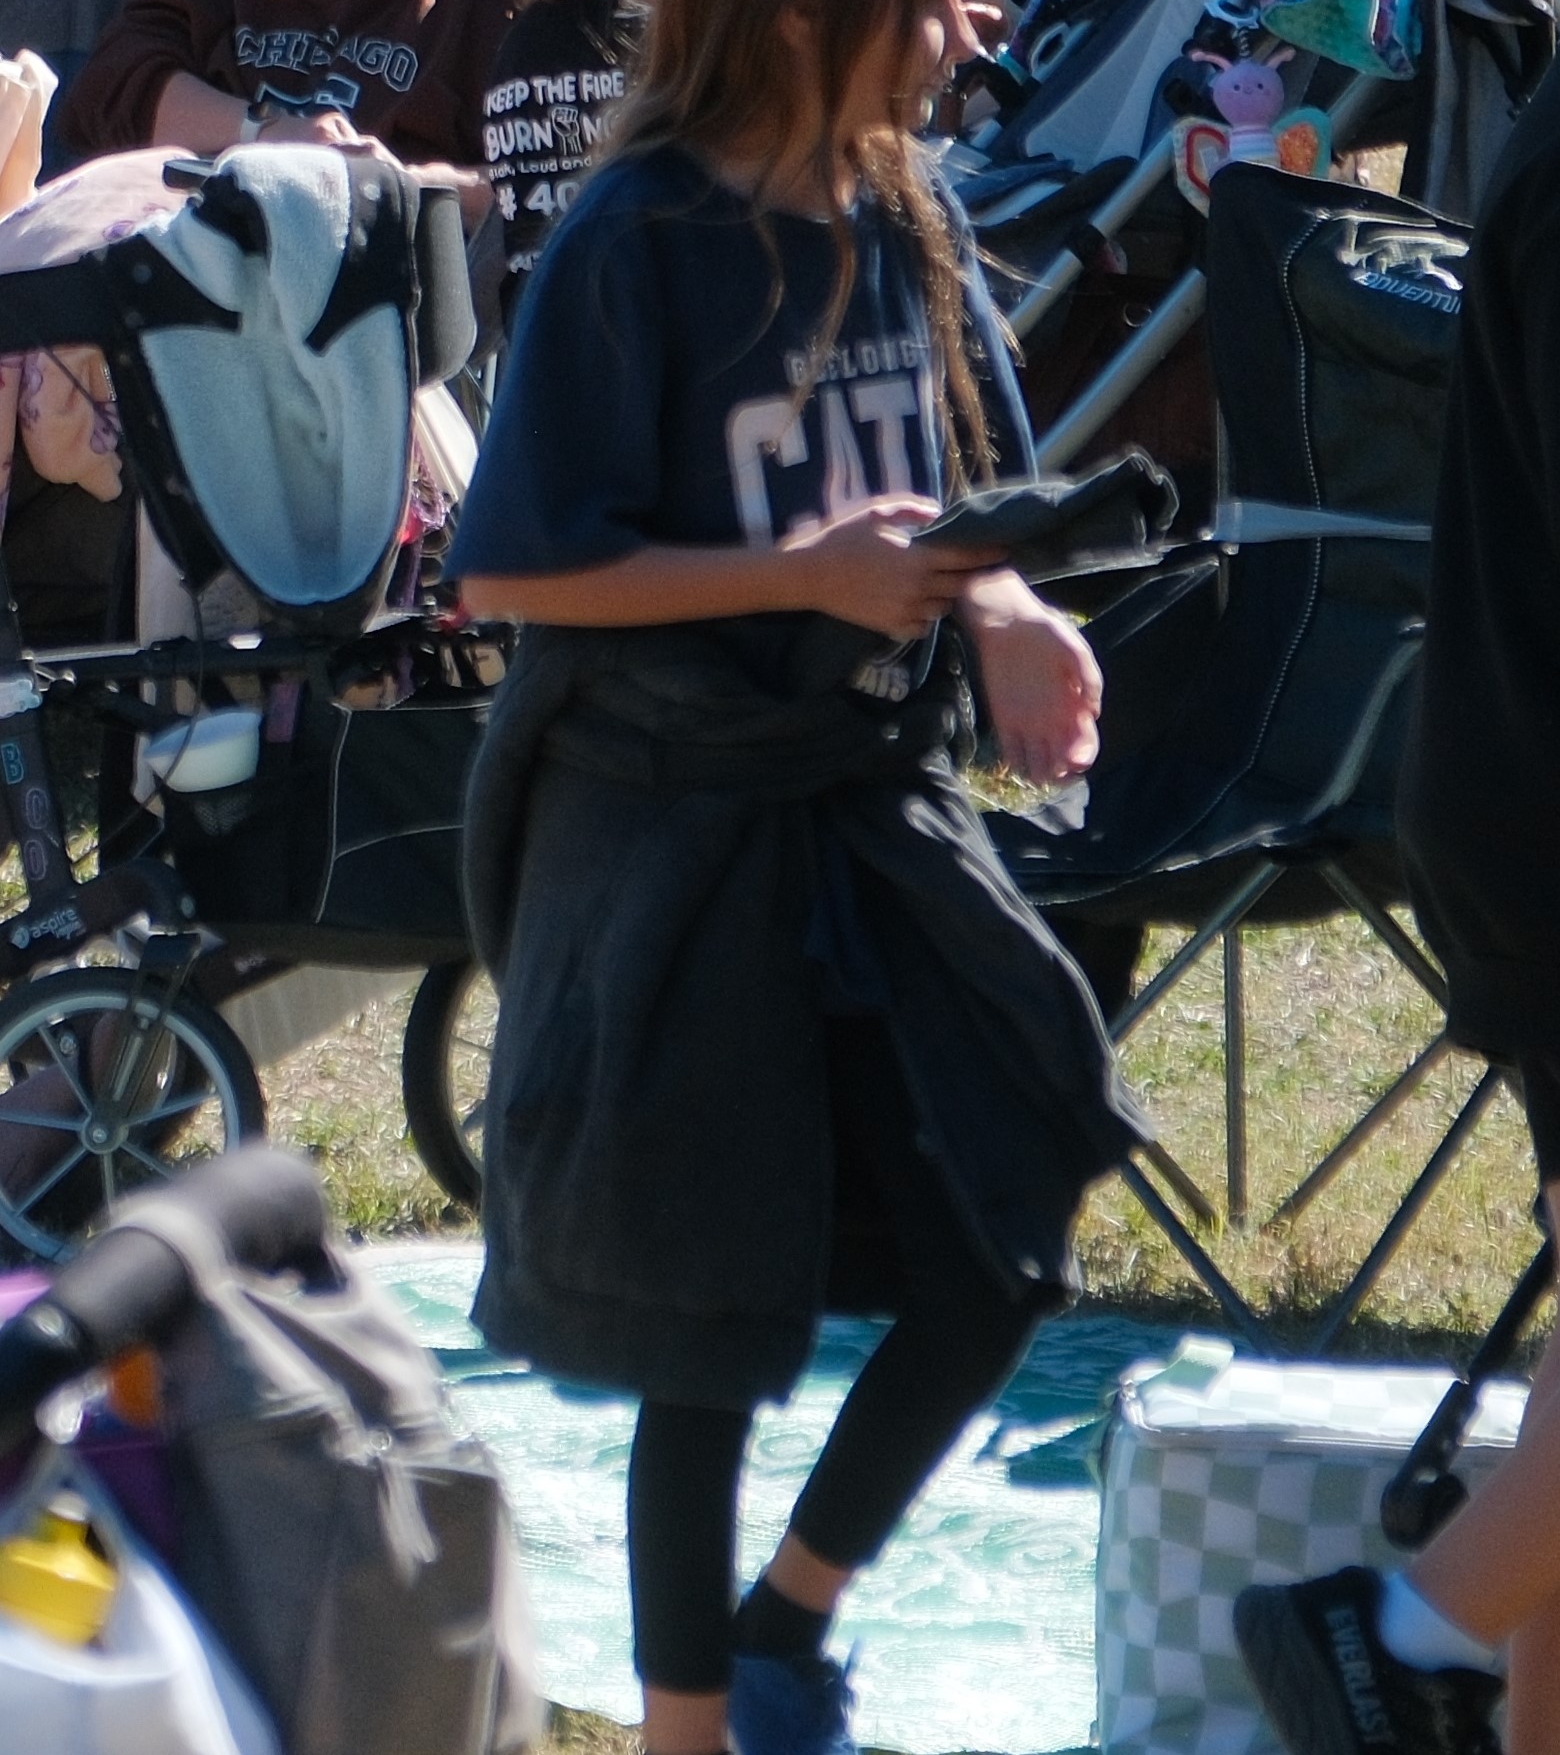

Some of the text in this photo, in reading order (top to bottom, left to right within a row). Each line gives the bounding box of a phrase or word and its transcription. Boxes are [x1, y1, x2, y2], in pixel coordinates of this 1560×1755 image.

[484, 70, 625, 118] KEEP THE FIRE
[519, 158, 559, 175] Loud
[561, 155, 593, 171] and
[726, 378, 920, 546] CAT
[29, 908, 79, 939] aspire
